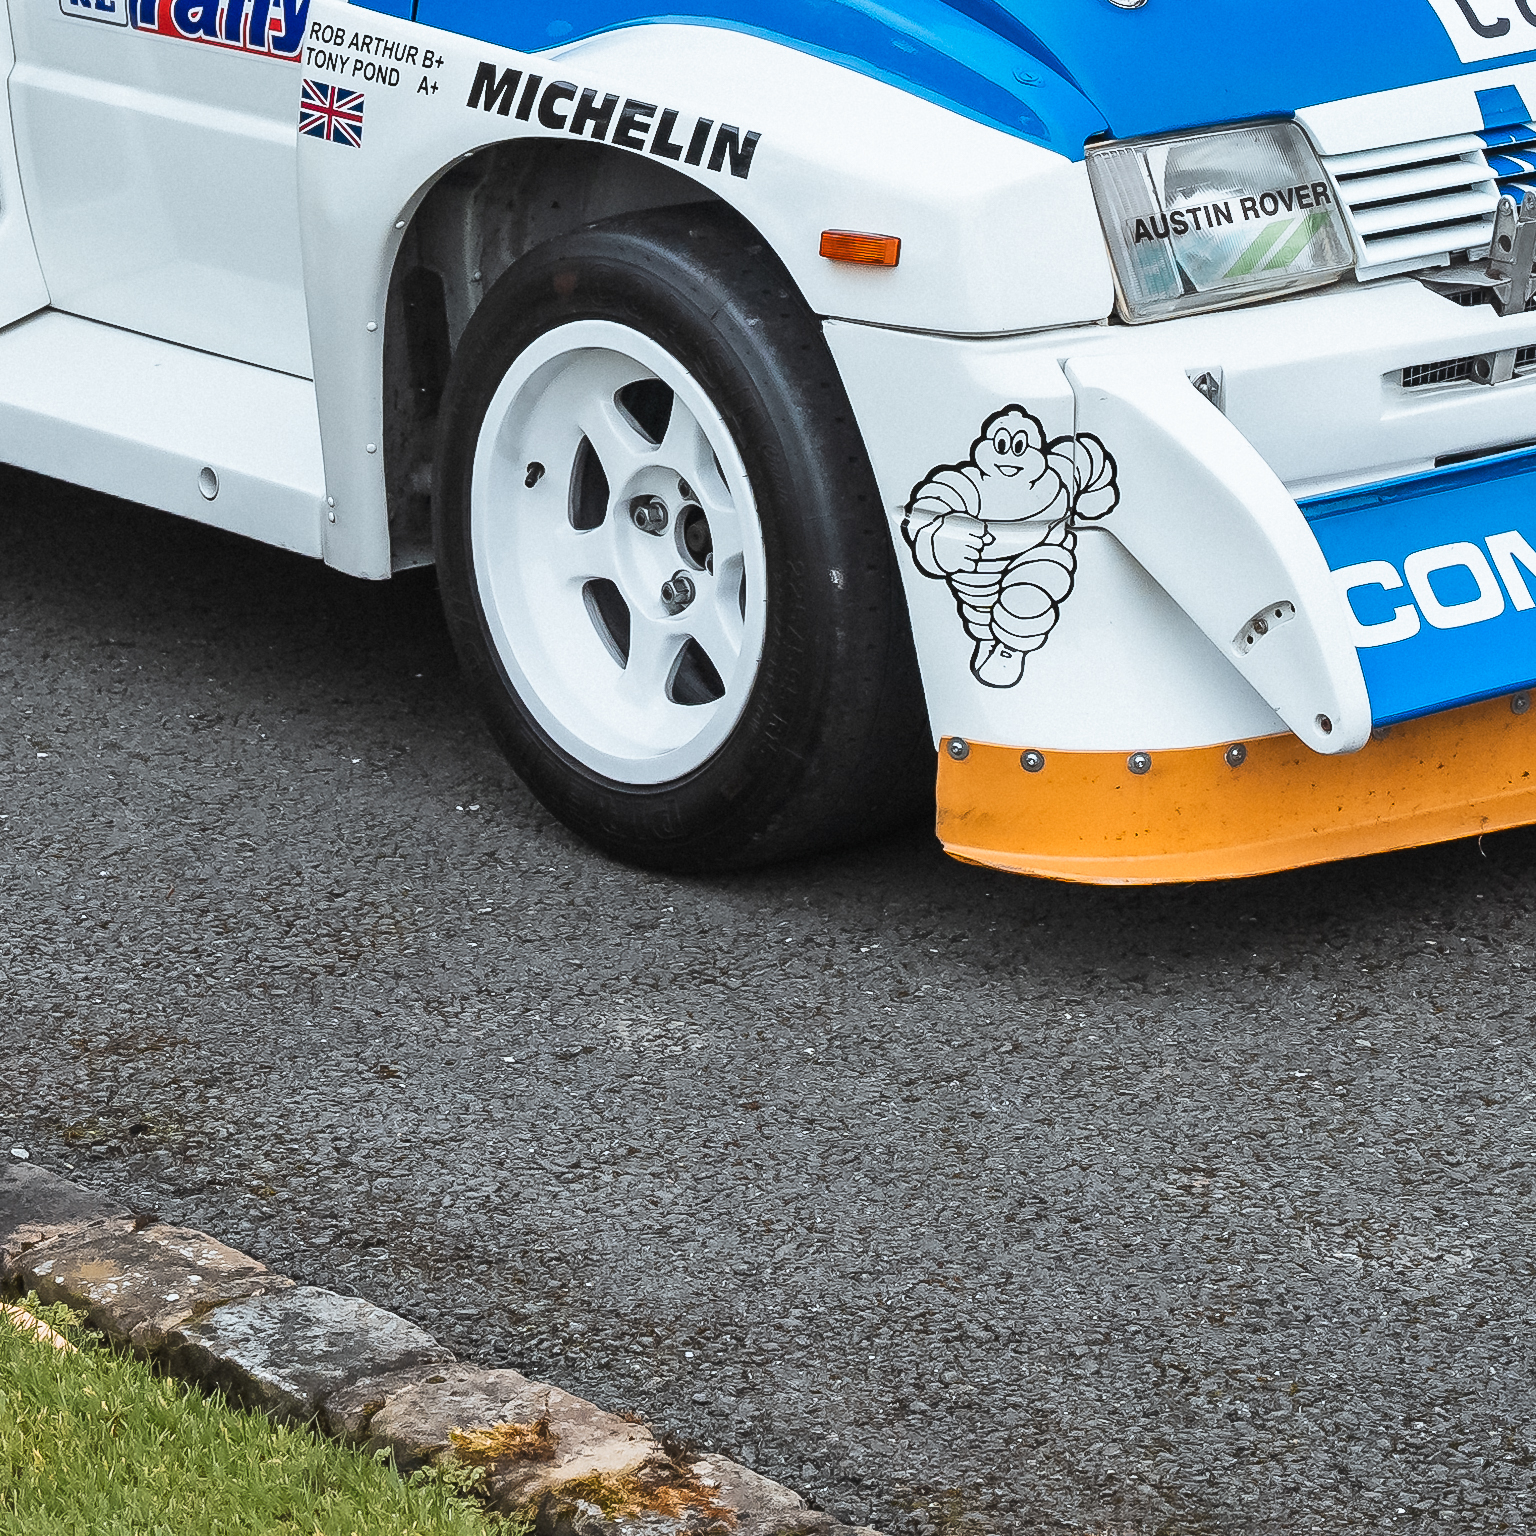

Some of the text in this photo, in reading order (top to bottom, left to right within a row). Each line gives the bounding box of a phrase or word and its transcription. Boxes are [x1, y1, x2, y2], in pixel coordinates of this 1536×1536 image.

[306, 47, 439, 96] TONY POND A+
[309, 21, 445, 69] ROB ARTHUR B+
[466, 61, 762, 180] MICHELIN
[1134, 180, 1332, 244] AUSTIN ROVER
